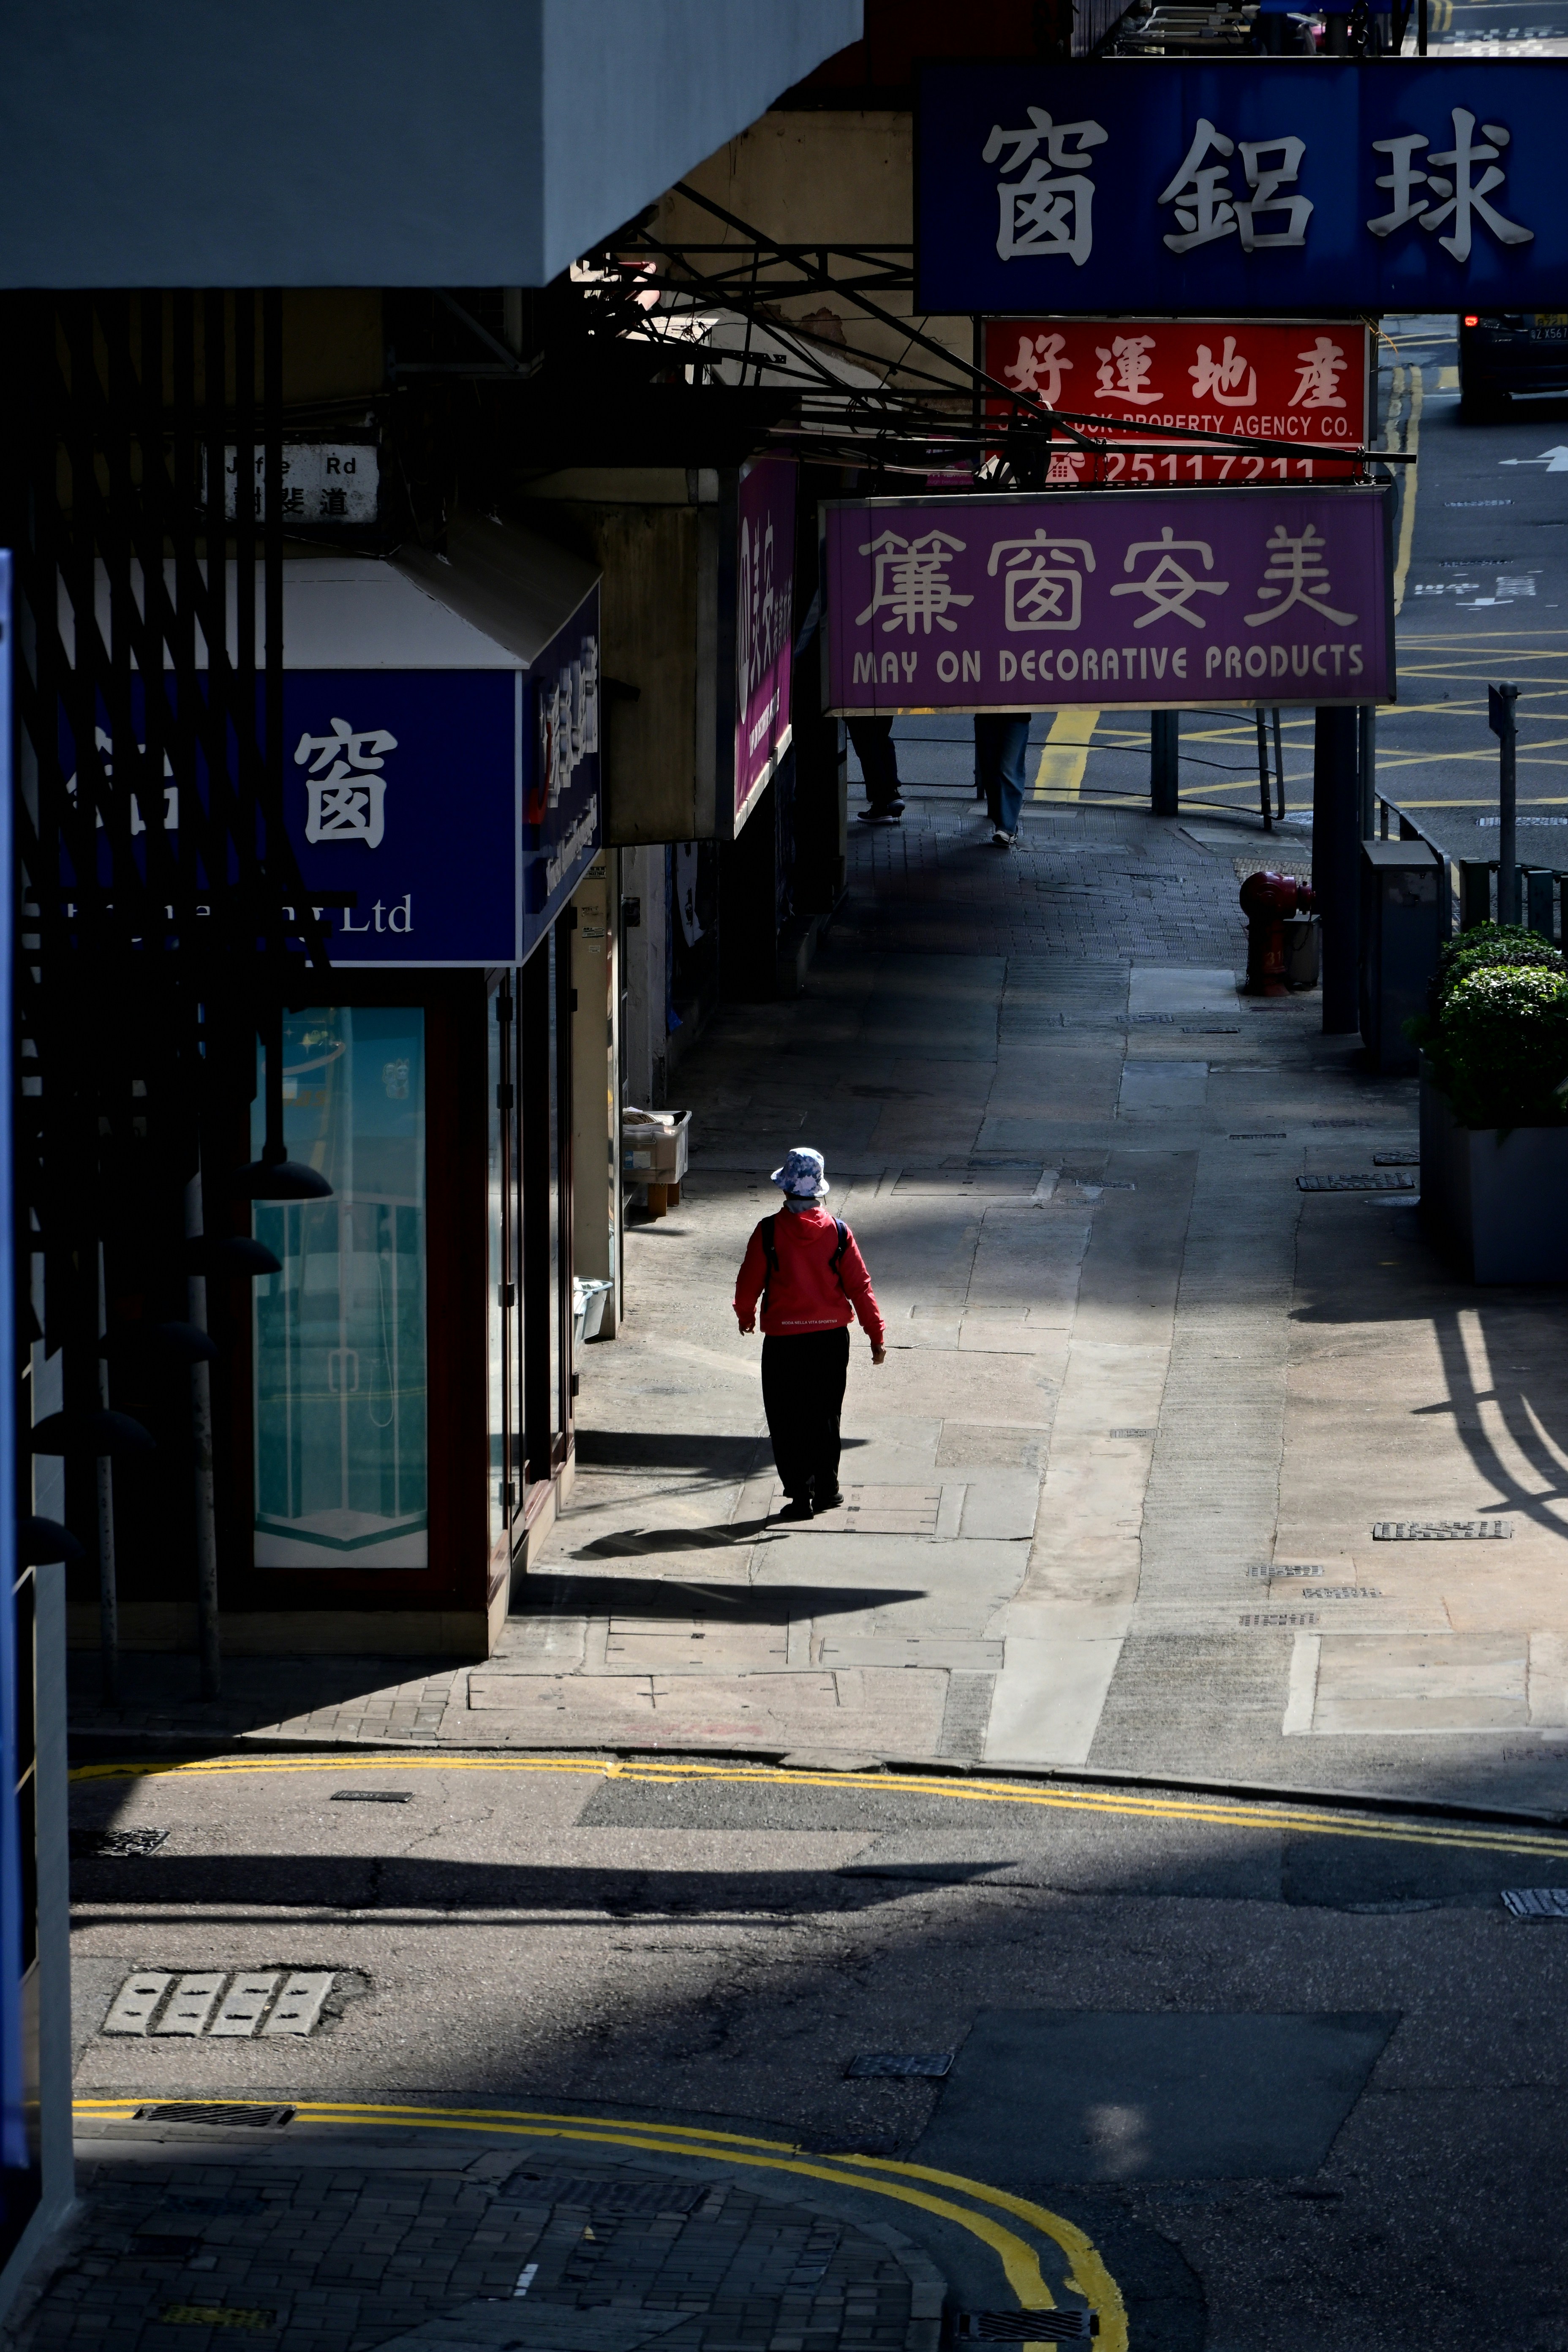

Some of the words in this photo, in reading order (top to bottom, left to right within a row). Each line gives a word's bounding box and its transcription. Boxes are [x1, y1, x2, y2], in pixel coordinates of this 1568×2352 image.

[1004, 333, 1348, 408] 好運地產
[1232, 415, 1312, 436] AGENCY
[1321, 416, 1353, 437] CO.
[327, 457, 356, 474] Rd
[1106, 452, 1313, 482] 25117211
[852, 651, 918, 683] MAY
[936, 650, 980, 683] ON
[999, 647, 1187, 682] DECORATIVE
[1206, 644, 1364, 678] PRODUCTS
[339, 893, 414, 933] Ltd
